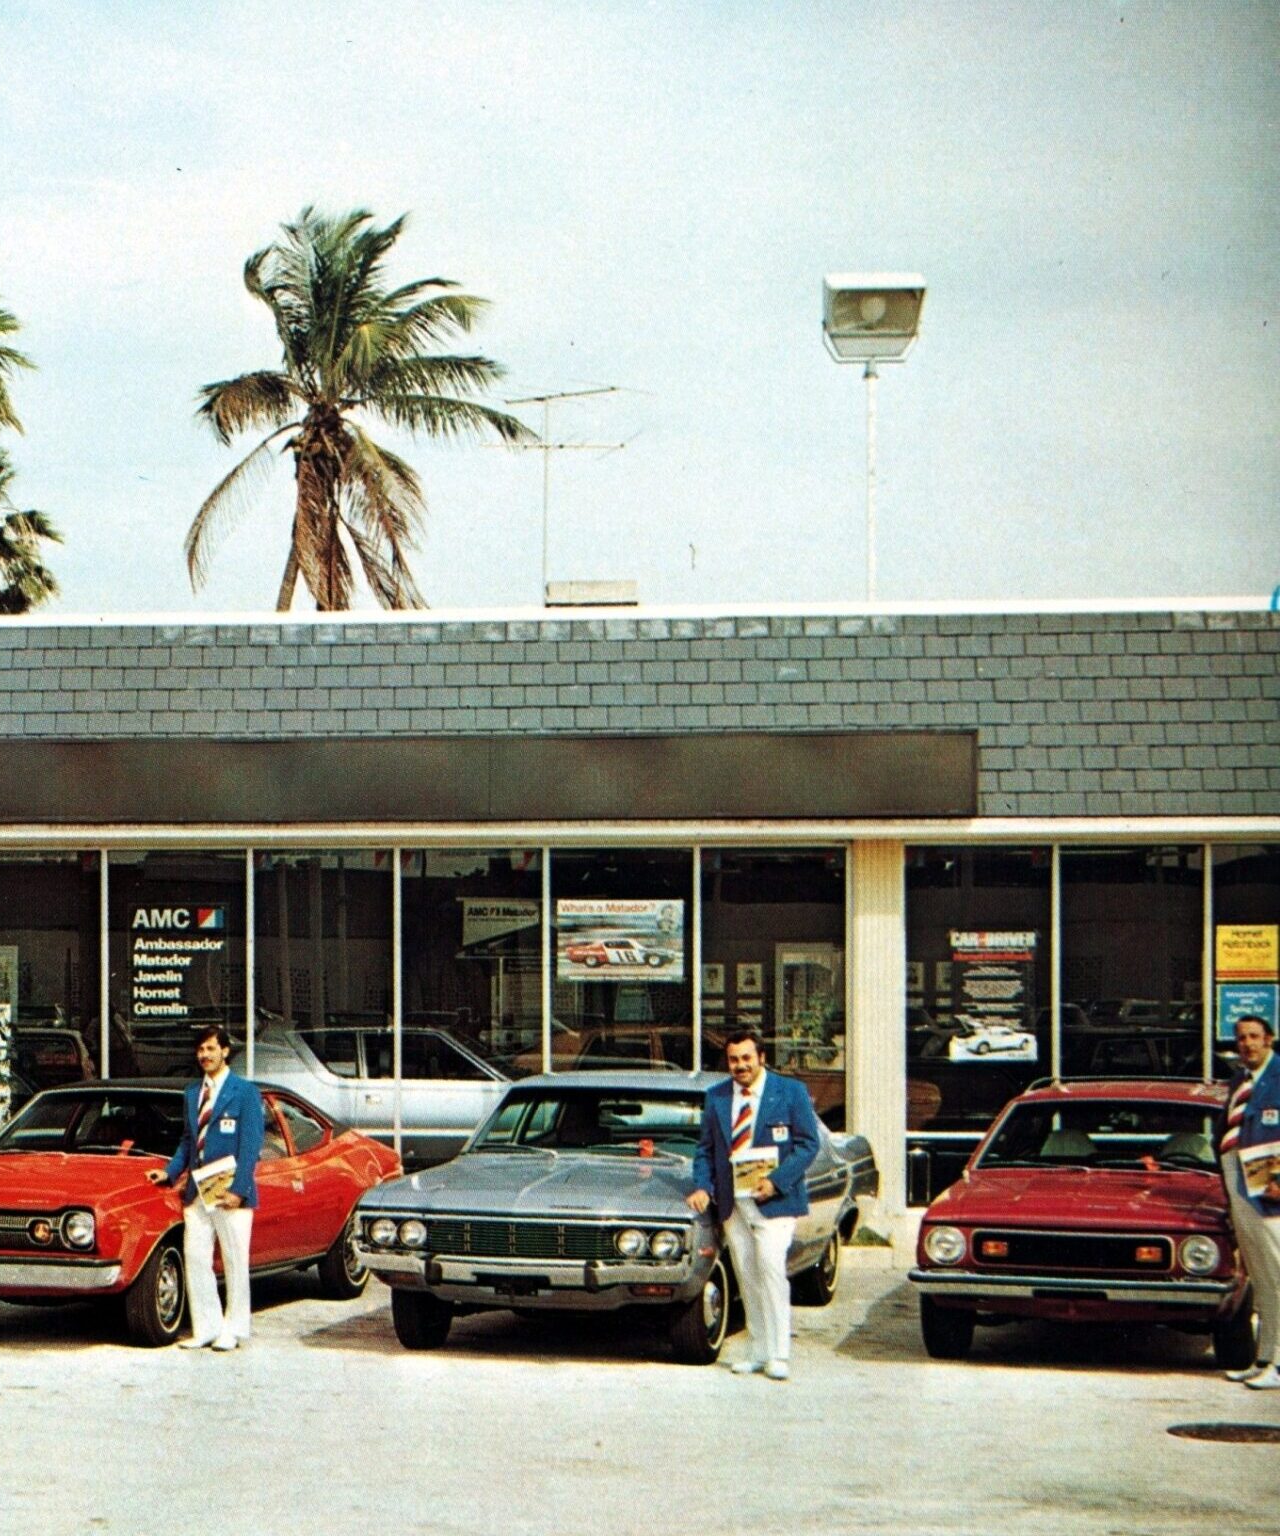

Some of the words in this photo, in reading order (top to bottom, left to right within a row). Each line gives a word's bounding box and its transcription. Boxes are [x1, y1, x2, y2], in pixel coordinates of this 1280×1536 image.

[467, 907, 488, 917] AMC
[560, 902, 593, 912] What's
[132, 908, 190, 929] AMC
[134, 938, 224, 951] Ambassador
[950, 931, 977, 947] CAR
[987, 931, 1036, 947] DRIVER
[133, 953, 192, 967] Matador
[615, 950, 637, 962] 16
[133, 970, 183, 983] Javelin
[133, 986, 181, 999] Hornet
[133, 1002, 188, 1015] Gremlin
